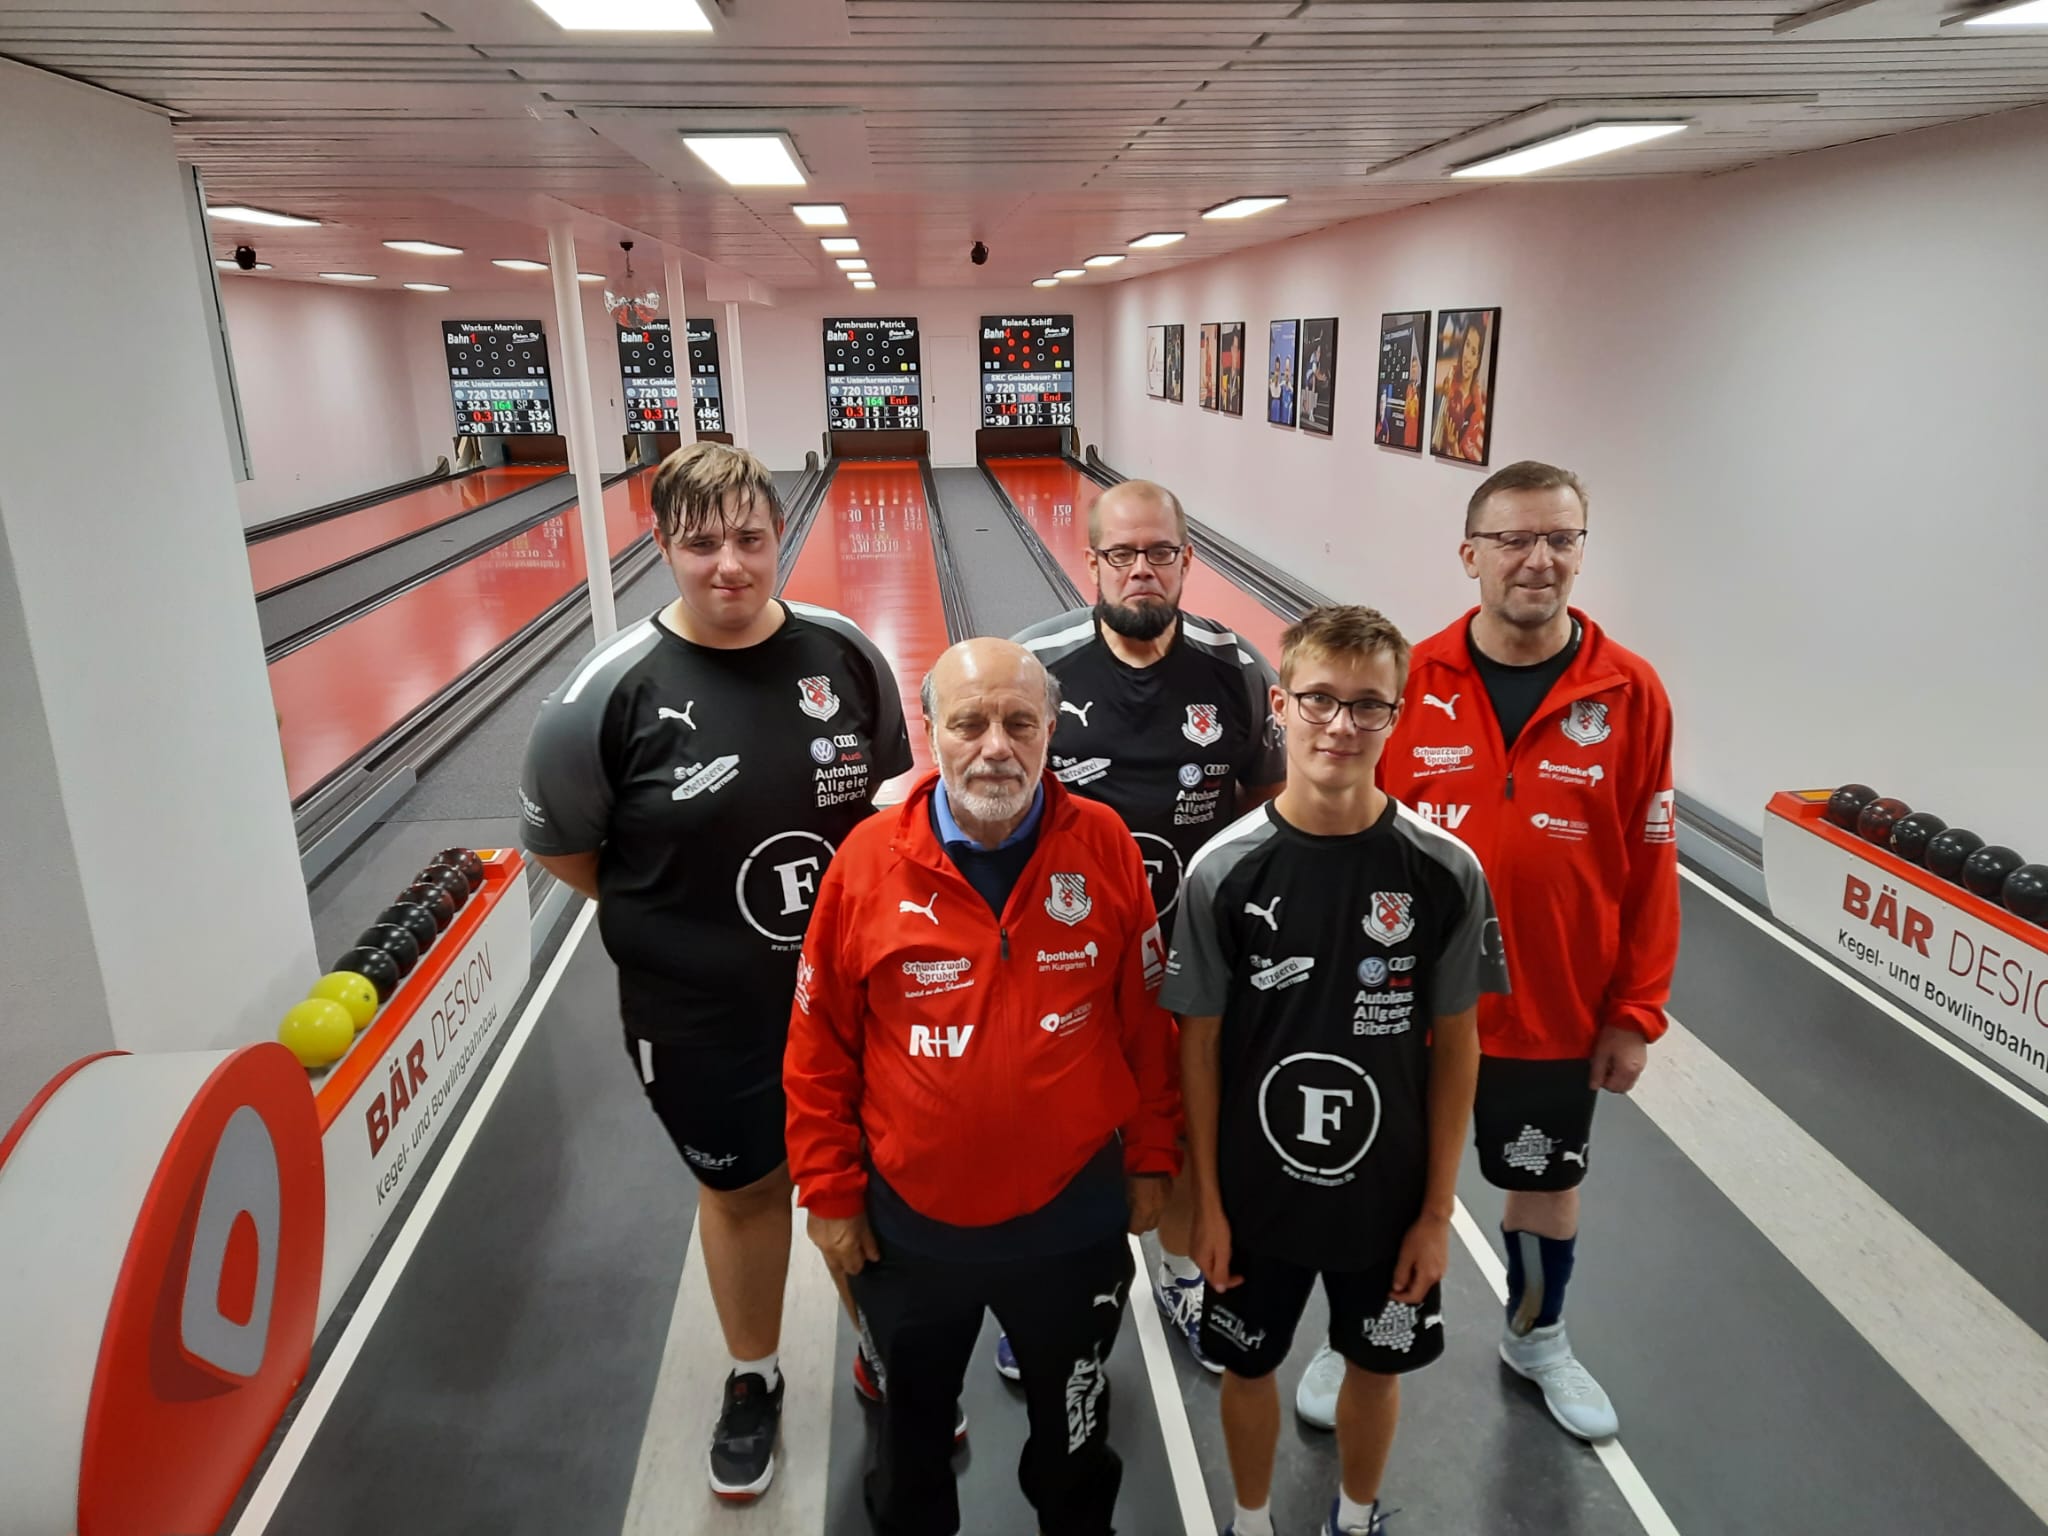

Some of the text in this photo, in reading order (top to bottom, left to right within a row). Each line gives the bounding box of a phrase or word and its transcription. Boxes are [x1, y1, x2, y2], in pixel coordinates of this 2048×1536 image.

[638, 399, 661, 408] 21.3
[841, 397, 863, 406] 38.4
[890, 396, 908, 404] End
[995, 394, 1017, 403] 31.3
[1043, 393, 1061, 402] End
[467, 401, 490, 410] 32.3
[1001, 405, 1017, 414] 1.6
[1050, 403, 1071, 413] 516
[473, 411, 492, 421] 0.3
[528, 410, 550, 420] 534
[644, 409, 662, 419] 0.3
[697, 408, 719, 418] 486
[846, 407, 864, 417] 0.3
[897, 407, 919, 416] 549
[641, 421, 656, 430] 30
[699, 420, 720, 429] 126
[842, 419, 857, 428] 30
[899, 418, 918, 427] 121
[996, 416, 1010, 425] 30
[1051, 415, 1071, 424] 126
[470, 423, 486, 433] 30
[530, 422, 552, 432] 159
[815, 764, 868, 781] Autohaus
[816, 776, 869, 794] Allgeier
[816, 787, 866, 808] Biberach
[1842, 873, 1934, 959] BÄR
[1037, 950, 1086, 964] Apotheke
[903, 957, 972, 975] Schwarzwald
[1052, 962, 1088, 973] Kurgarten
[917, 971, 960, 986] Sprudel
[1354, 990, 1415, 1005] Autohaus
[1838, 928, 2048, 1074] Kegel- und Bowlingbahn
[1353, 1005, 1414, 1022] Allgeier
[908, 1024, 975, 1058] R+V
[365, 941, 493, 1159] BÄR DESIGN
[375, 1002, 499, 1206] Kegel- und Bowlingbahnbau
